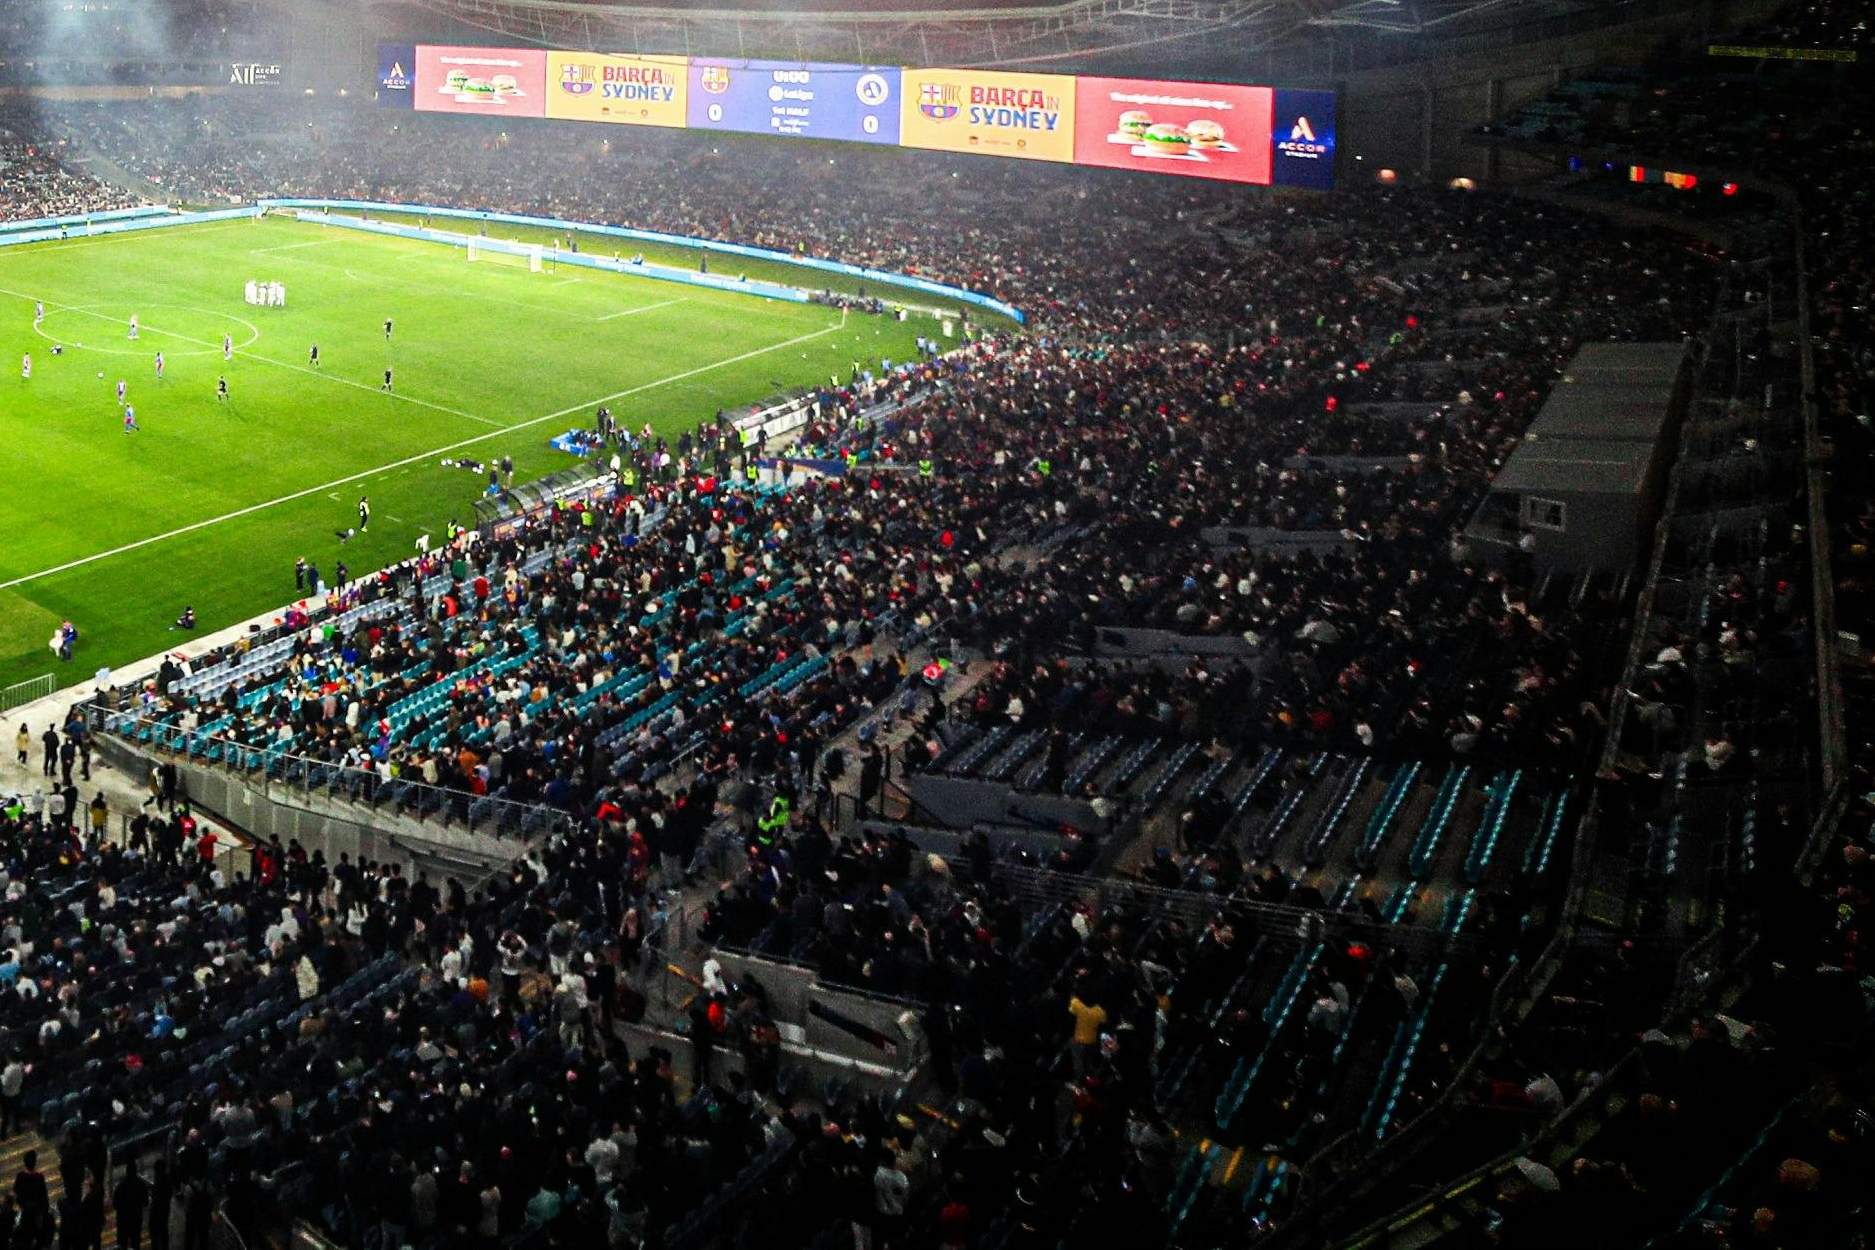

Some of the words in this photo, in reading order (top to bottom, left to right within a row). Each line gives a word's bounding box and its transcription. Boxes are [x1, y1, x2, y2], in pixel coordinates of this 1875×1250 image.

[602, 65, 663, 86] BARÇA
[664, 72, 675, 85] IN
[601, 83, 675, 102] SYDNEY
[970, 86, 1045, 111] BARÇA
[1046, 95, 1060, 110] IN
[708, 104, 723, 122] 0
[969, 107, 1058, 130] SYDNEY
[863, 115, 879, 134] 0
[1278, 141, 1326, 153] ACCOR
